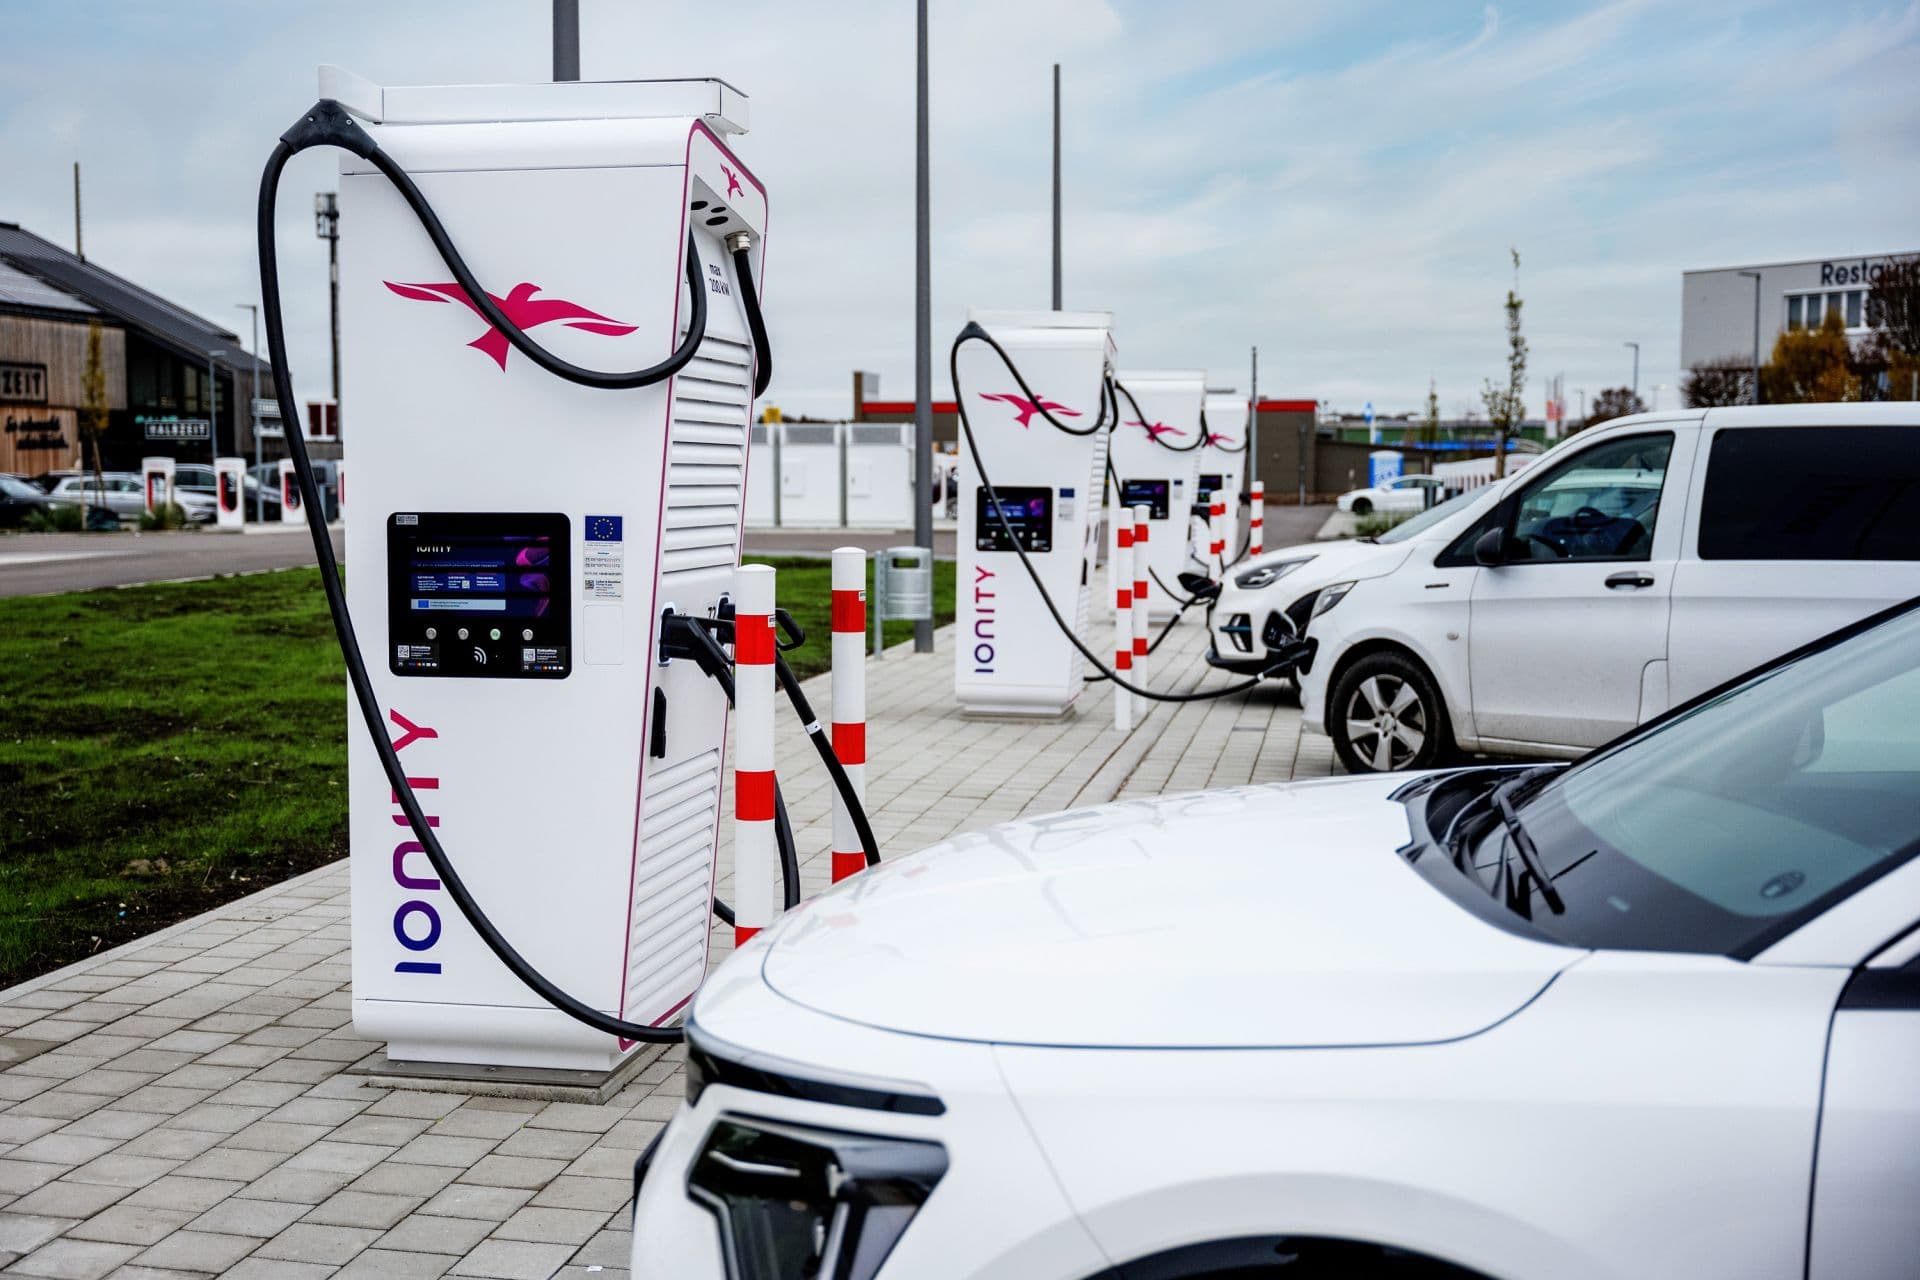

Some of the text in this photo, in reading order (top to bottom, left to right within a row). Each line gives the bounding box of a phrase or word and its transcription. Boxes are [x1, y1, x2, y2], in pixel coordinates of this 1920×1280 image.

[709, 264, 721, 276] max
[3, 370, 41, 395] ZEIT
[974, 565, 995, 673] IONITY
[390, 708, 441, 974] IONITY
